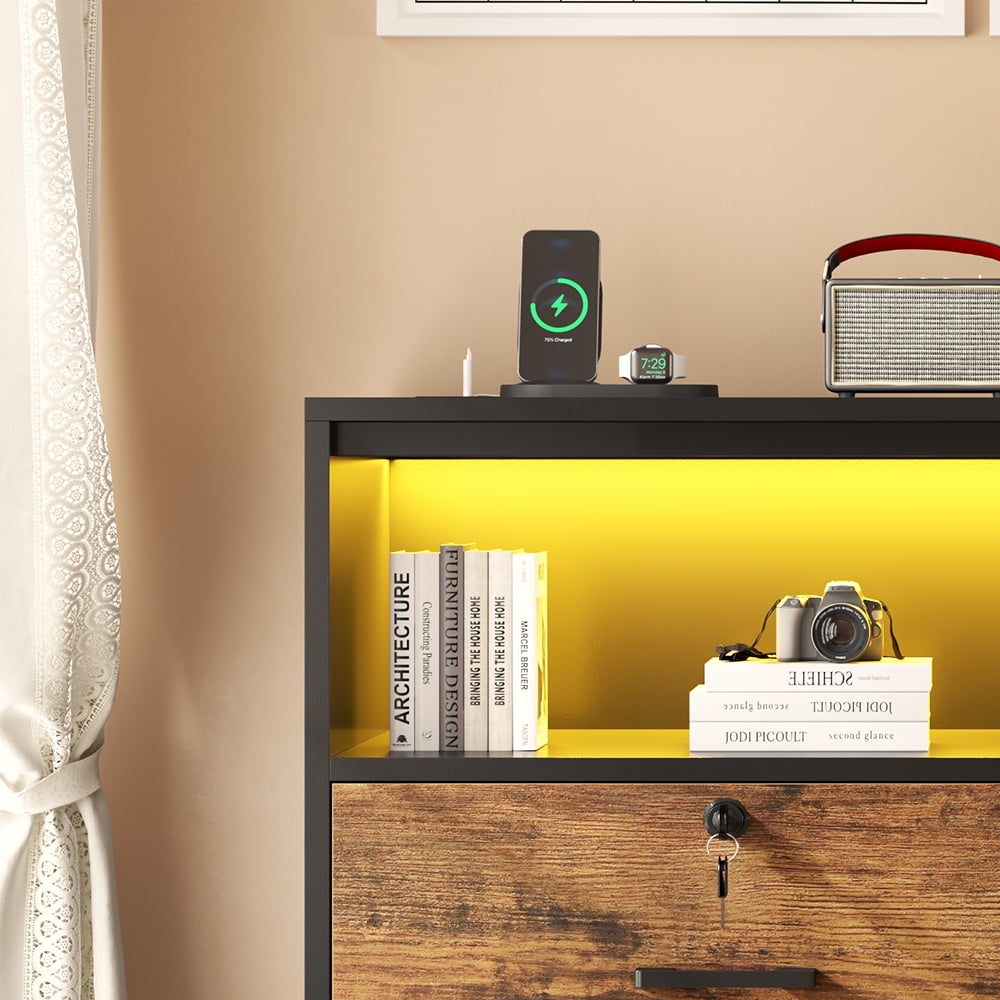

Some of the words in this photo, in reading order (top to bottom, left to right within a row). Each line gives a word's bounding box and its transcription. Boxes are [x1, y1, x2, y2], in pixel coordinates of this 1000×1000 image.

[641, 357, 667, 369] 7:29
[445, 549, 458, 667] FURNITURE
[470, 596, 481, 618] HOME
[494, 596, 505, 618] HOME
[420, 601, 433, 651] Constructing
[470, 621, 481, 647] HOUSE
[494, 621, 505, 647] HOUSE
[520, 620, 529, 655] MARCEL
[393, 572, 410, 725] ARCHITECTURE
[470, 649, 481, 665] THE
[494, 649, 505, 665] THE
[422, 652, 432, 685] Paradies
[520, 656, 529, 690] BREUER
[470, 667, 481, 706] BRINGING
[494, 667, 505, 706] BRINGING
[445, 674, 459, 749] DESIGN
[725, 731, 752, 744] JODI
[755, 731, 807, 743] PICOULT
[828, 730, 861, 741] second
[864, 730, 895, 743] glance
